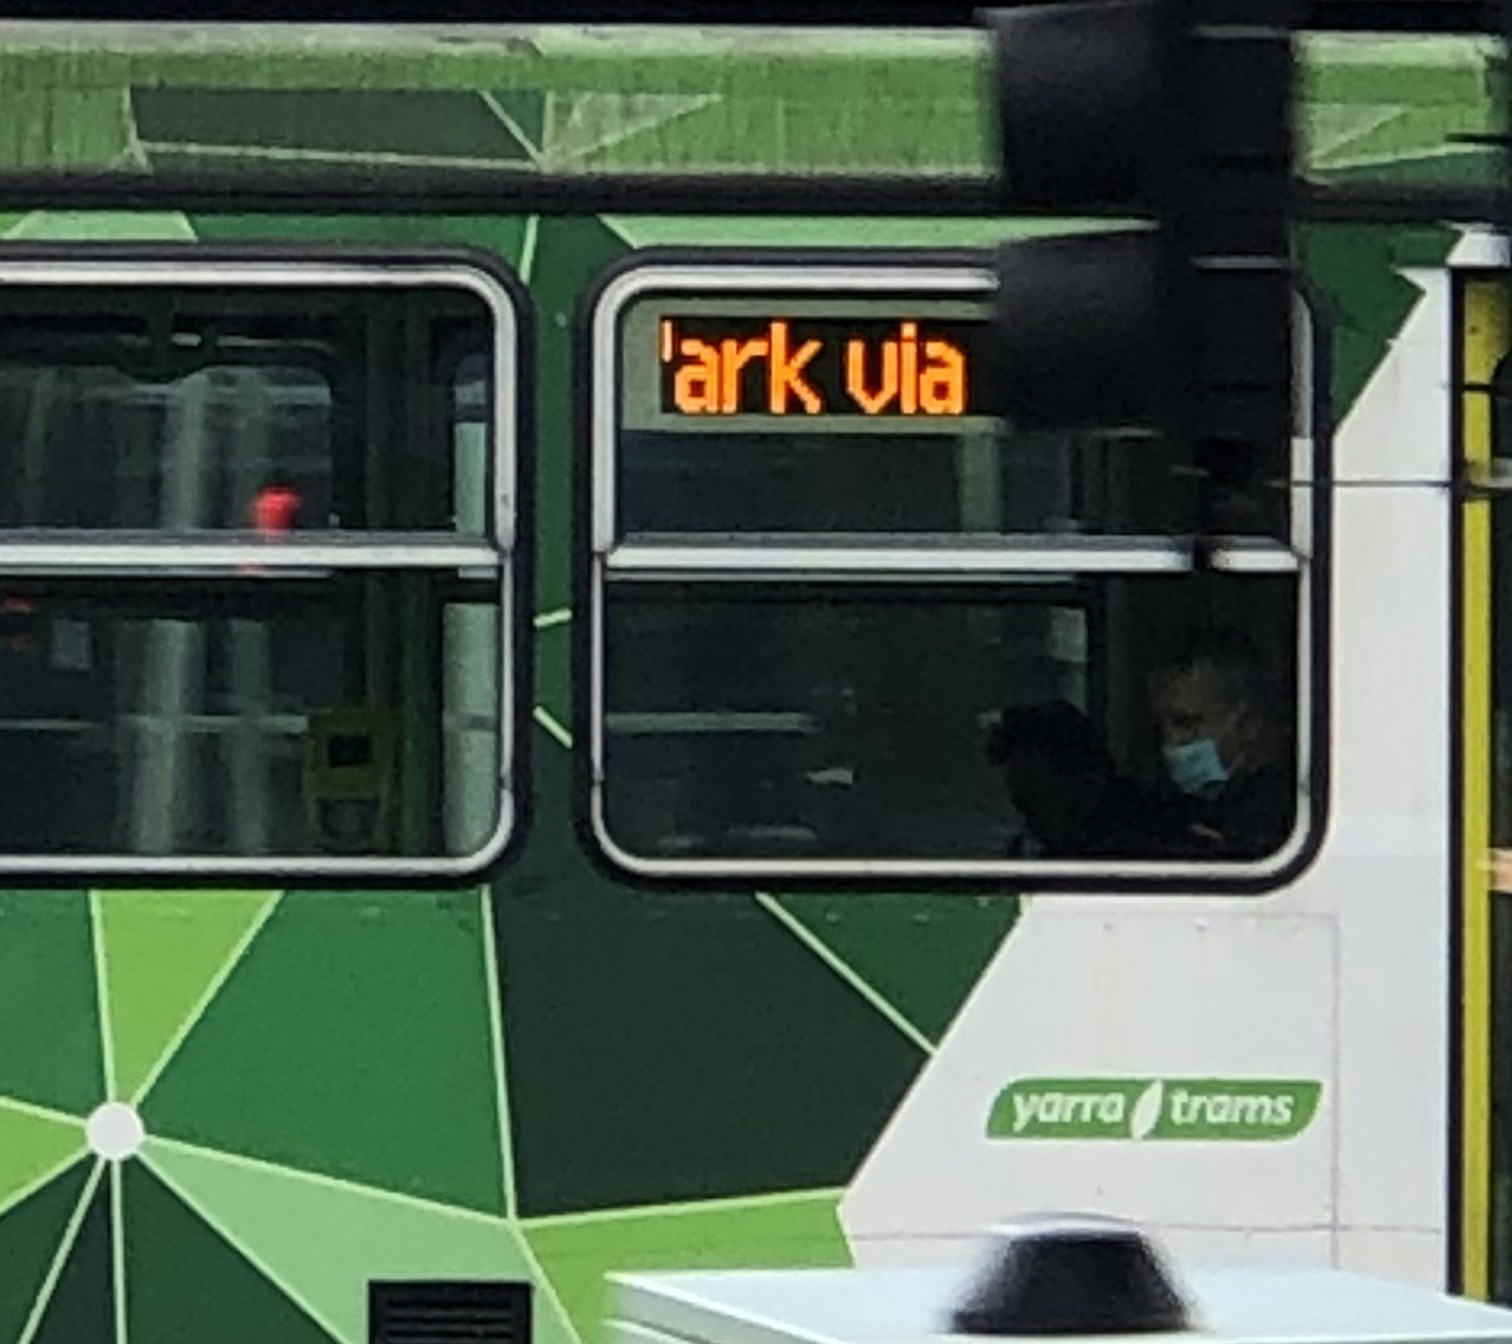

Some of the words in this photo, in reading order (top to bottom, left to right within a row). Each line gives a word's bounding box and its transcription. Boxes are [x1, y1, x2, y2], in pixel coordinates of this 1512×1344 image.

[661, 318, 824, 415] ark
[845, 320, 968, 415] via
[1012, 1090, 1126, 1132] yarra
[1170, 1087, 1296, 1125] trams
